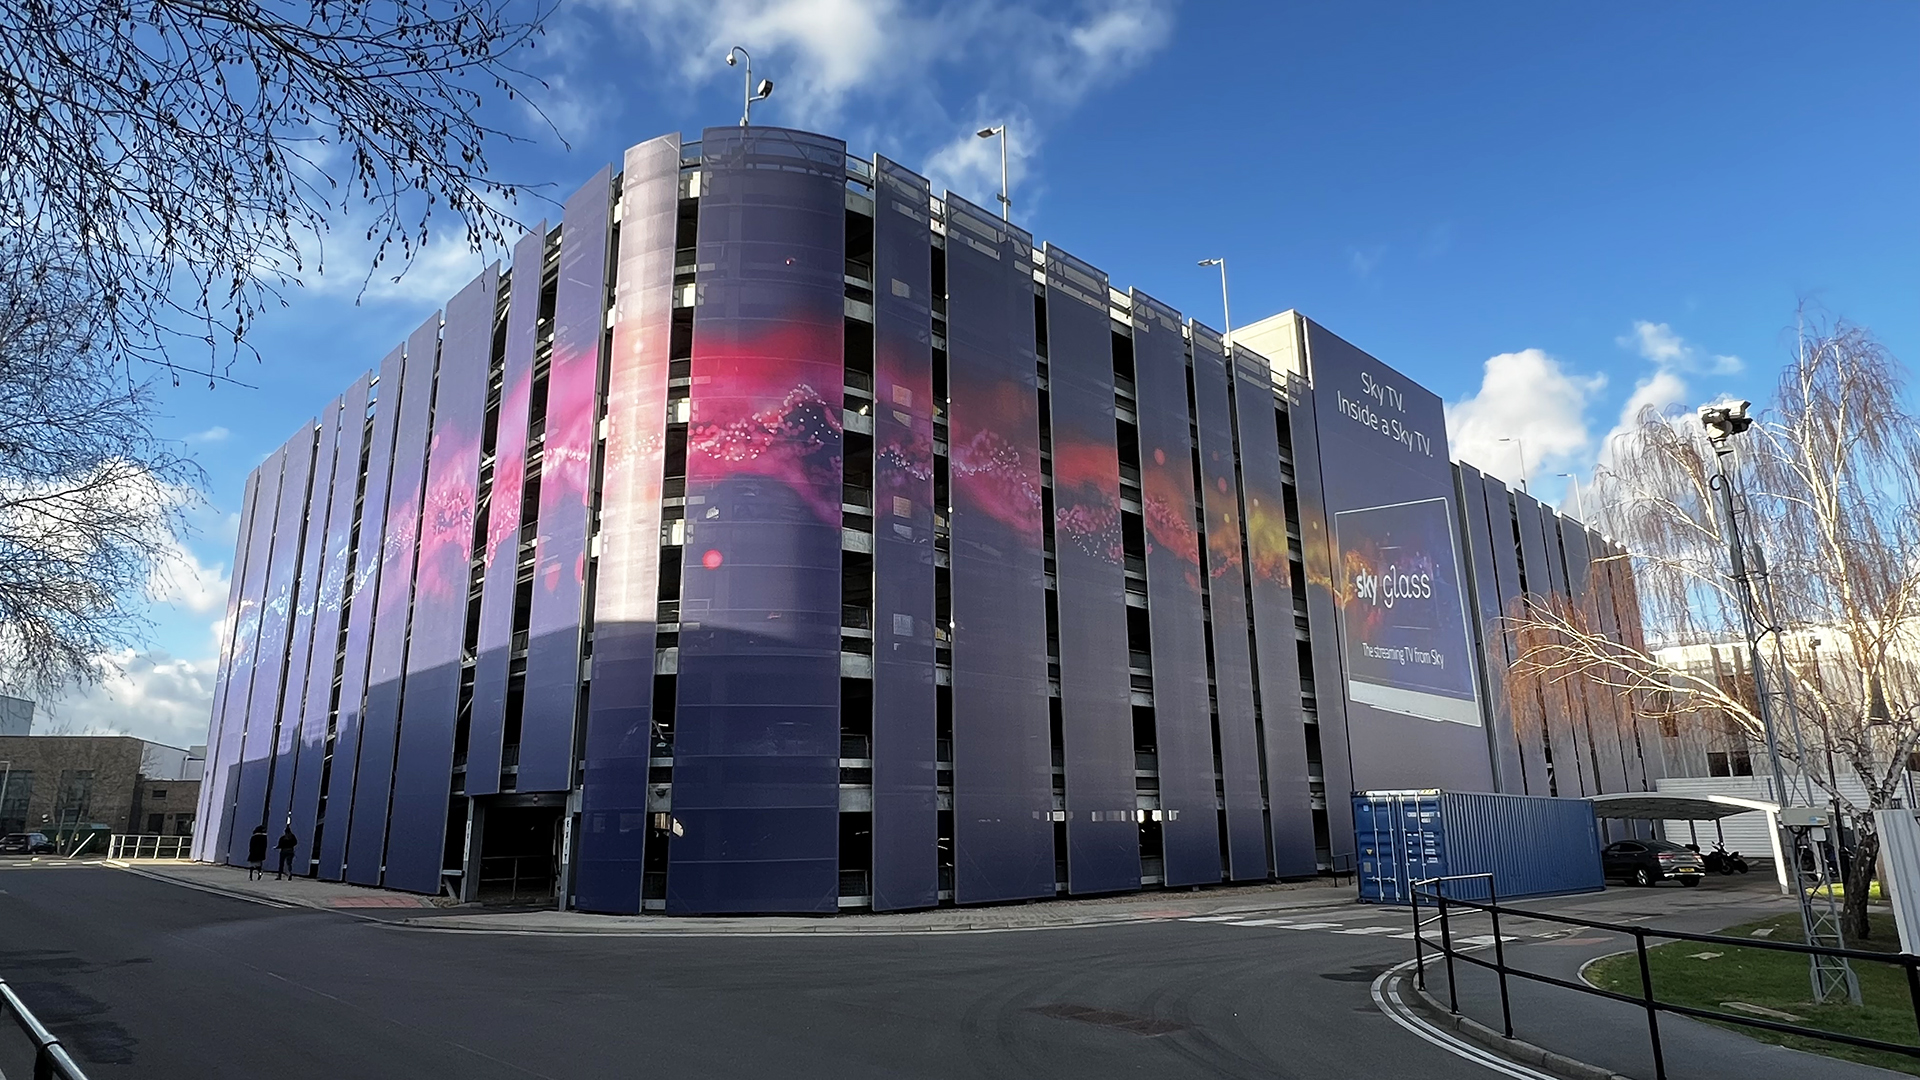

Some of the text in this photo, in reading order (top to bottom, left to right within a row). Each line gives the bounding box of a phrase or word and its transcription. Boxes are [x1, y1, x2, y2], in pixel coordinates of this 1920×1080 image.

[1361, 372, 1406, 413] Sky TV.
[1337, 390, 1433, 457] Inside a Sky TV.
[1356, 564, 1431, 608] sky glass
[1362, 642, 1444, 669] The streaming TV from Sky
